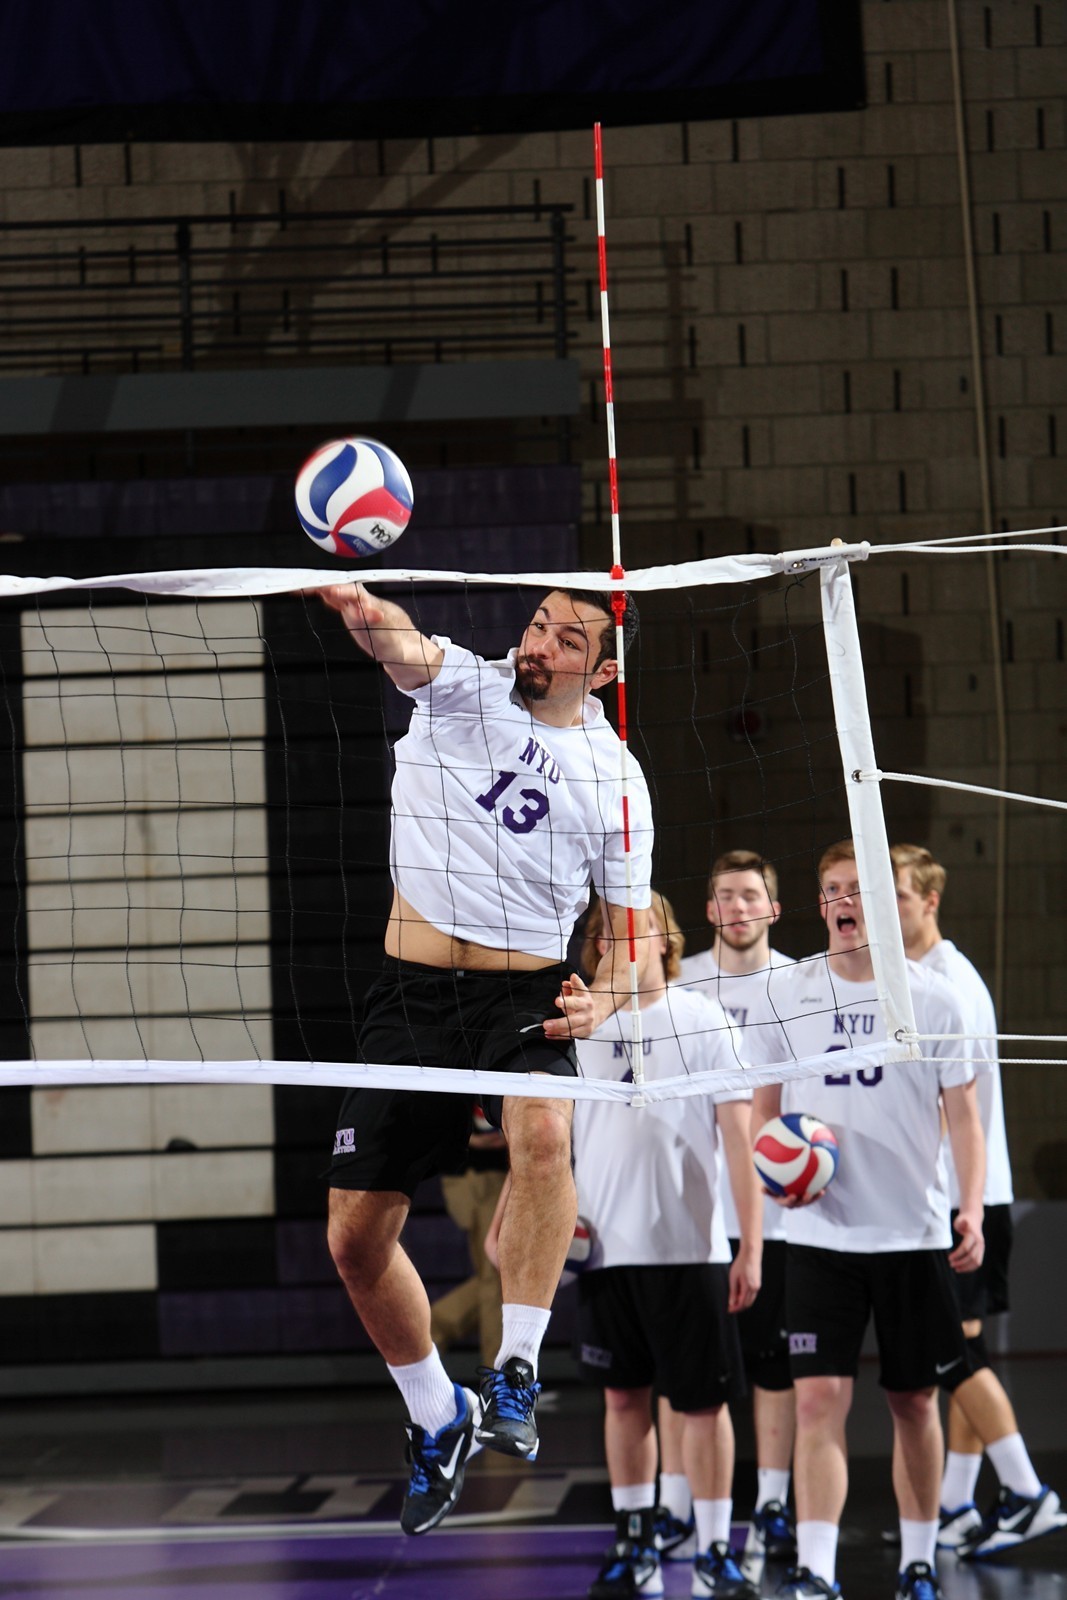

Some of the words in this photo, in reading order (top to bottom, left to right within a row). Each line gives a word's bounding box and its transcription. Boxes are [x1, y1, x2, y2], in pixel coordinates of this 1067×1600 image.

[519, 737, 560, 785] NYU
[475, 770, 550, 834] 13
[833, 1014, 875, 1034] NYU
[613, 1037, 652, 1059] NU
[336, 1128, 355, 1147] YU
